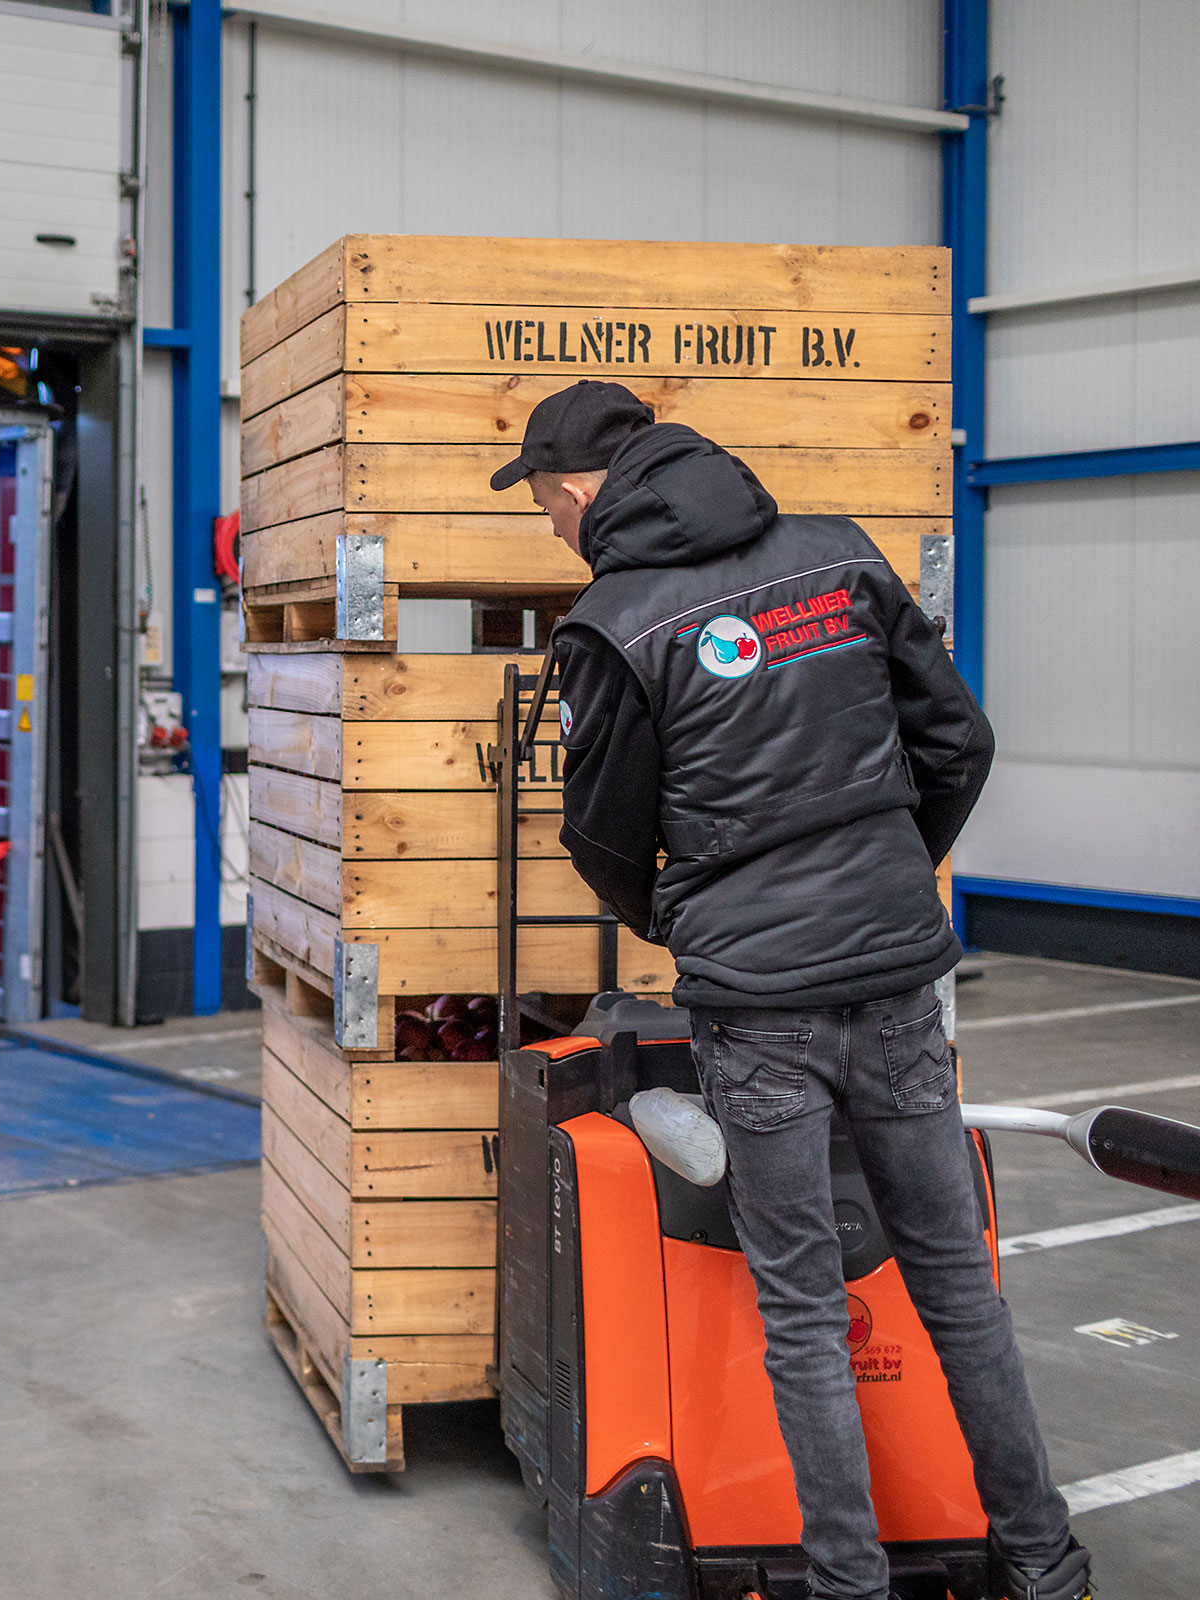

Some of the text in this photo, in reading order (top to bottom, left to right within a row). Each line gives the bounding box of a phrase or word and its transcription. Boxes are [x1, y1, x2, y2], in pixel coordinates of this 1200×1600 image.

[485, 319, 861, 368] WELLNER FRUIT B.V.
[750, 588, 853, 633] WELLNER
[764, 614, 849, 653] FRUIT BV
[554, 1224, 561, 1254] BT
[883, 1356, 902, 1370] bv
[884, 1345, 902, 1354] 672
